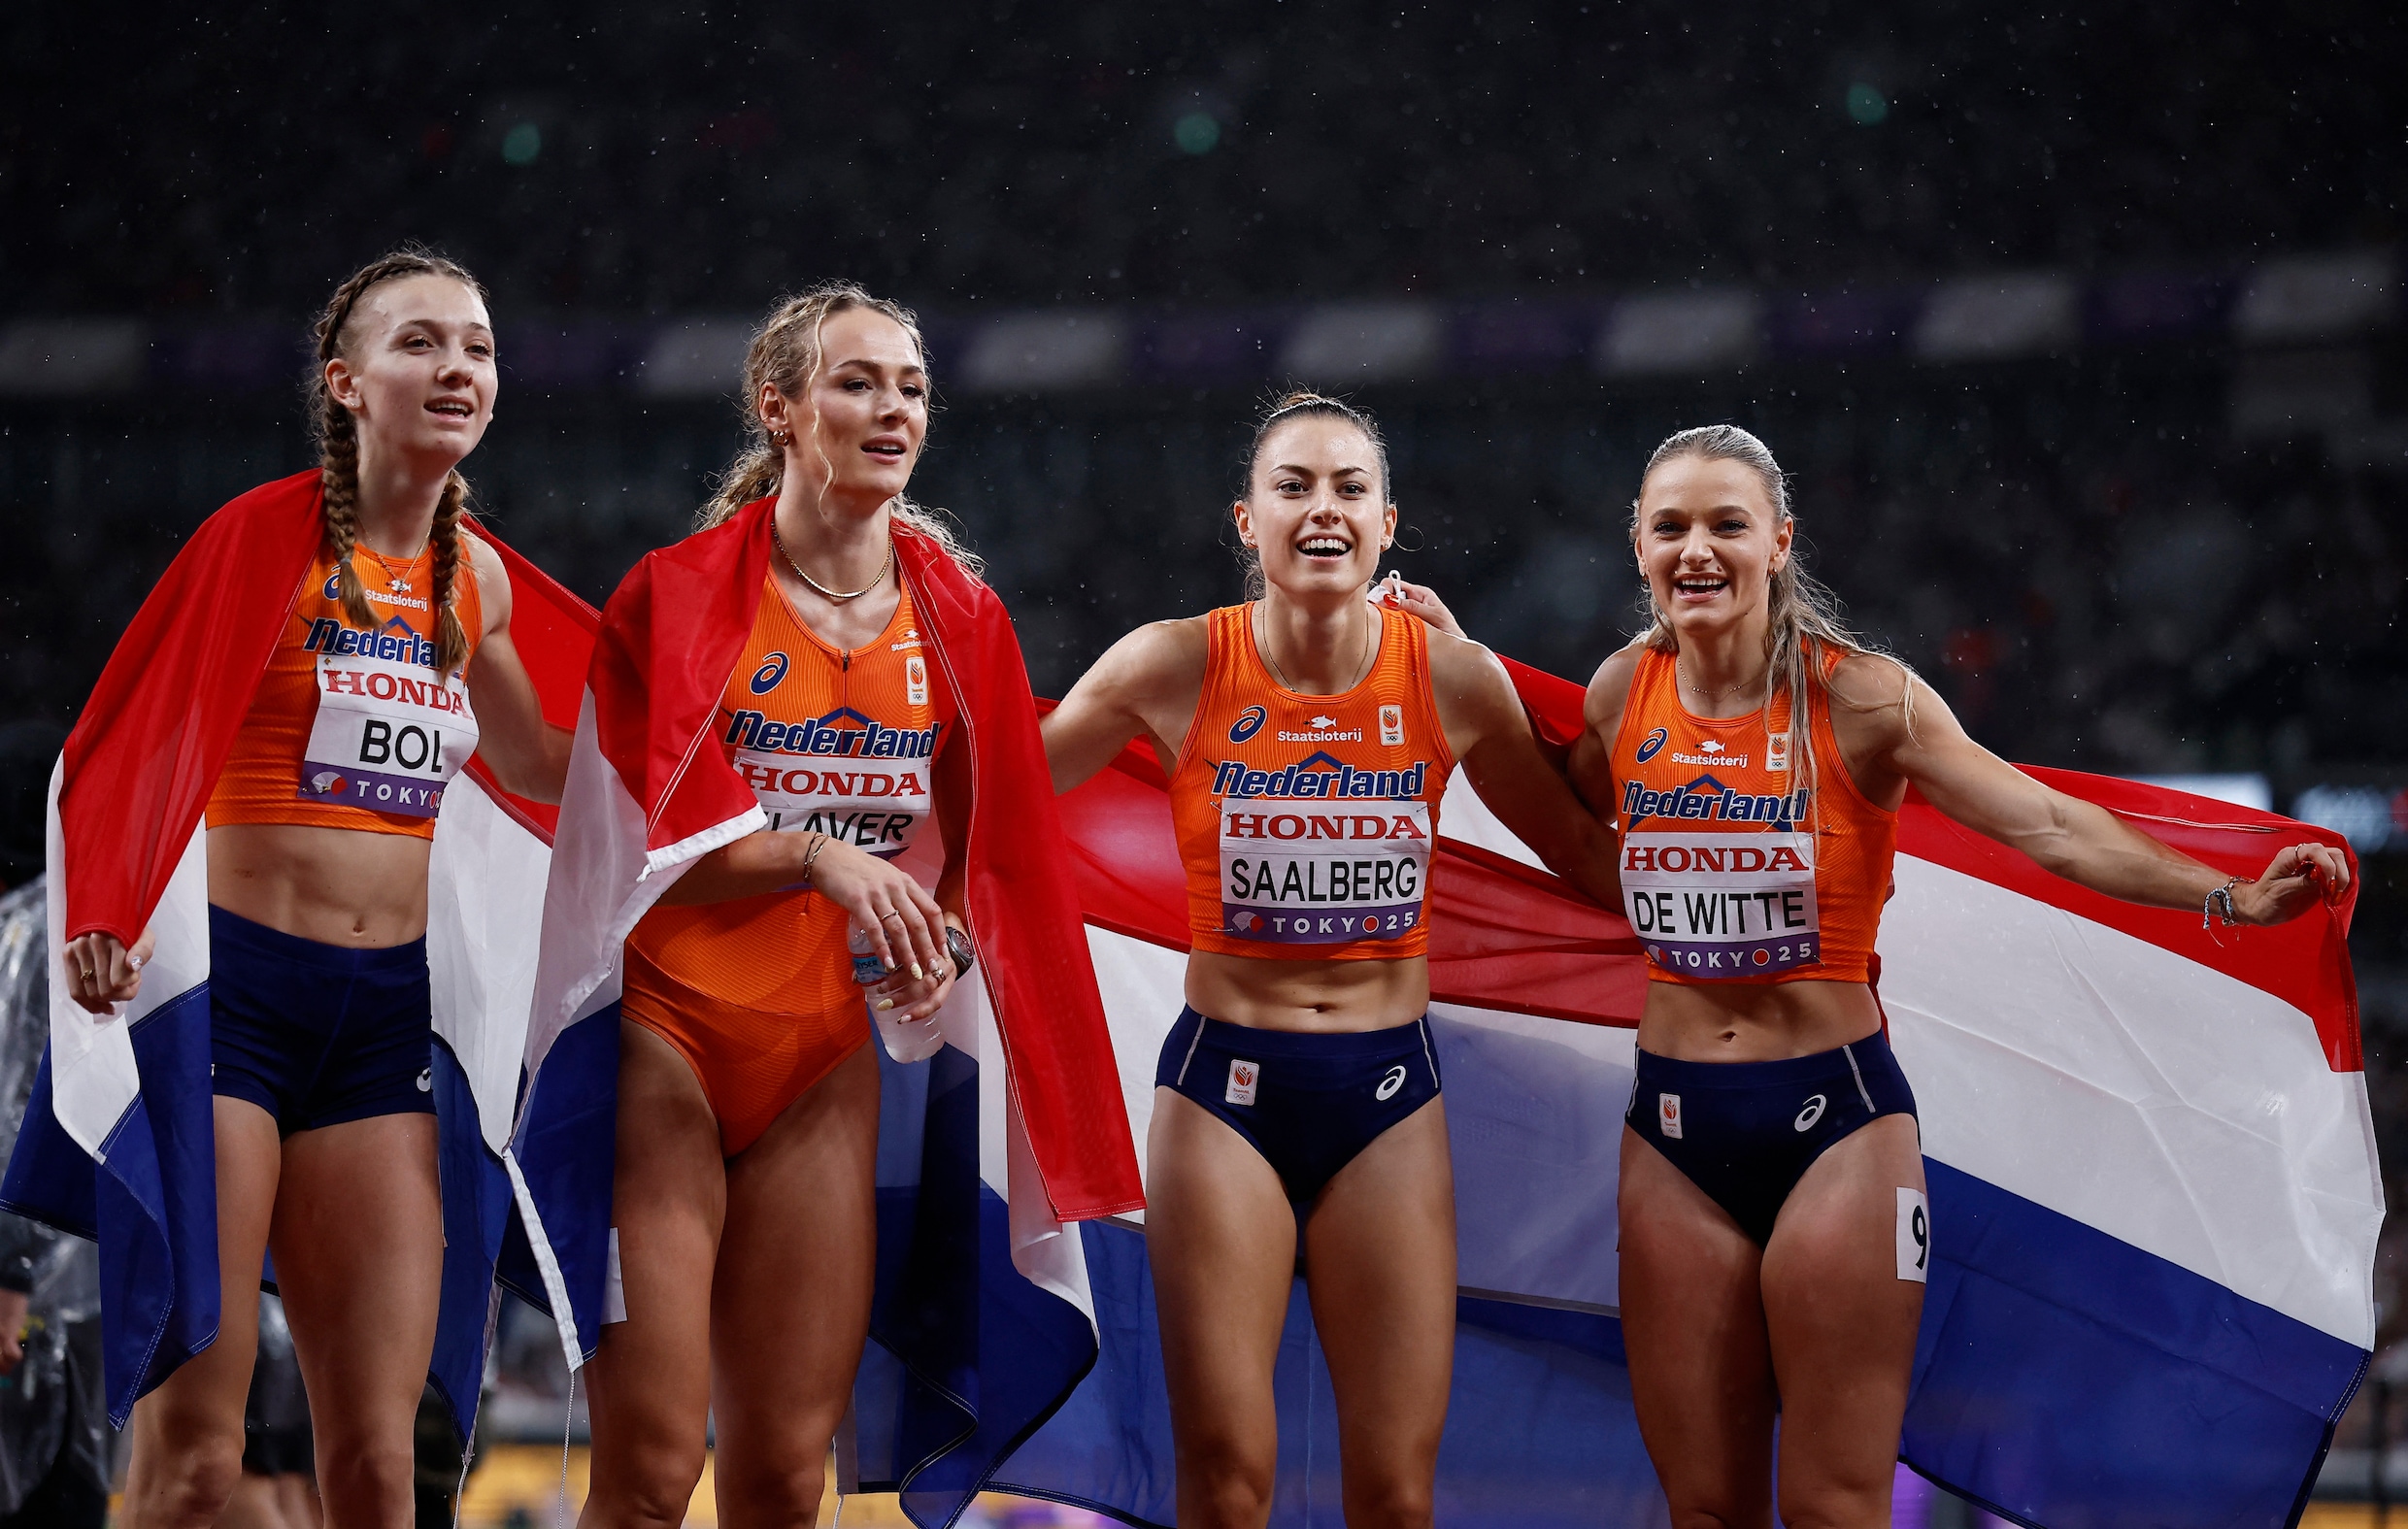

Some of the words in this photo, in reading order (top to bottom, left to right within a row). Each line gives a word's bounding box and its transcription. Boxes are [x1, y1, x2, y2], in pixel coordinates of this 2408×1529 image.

[365, 589, 428, 613] Staatsloterij
[302, 616, 465, 676] Nederla
[323, 668, 474, 720] HONDA
[358, 718, 443, 774] BOL
[1277, 728, 1362, 742] Staatsloterij
[1671, 752, 1748, 768] Staatsloterij
[739, 762, 926, 798] HONDA
[763, 812, 914, 847] AVER
[1225, 814, 1427, 841] HONDA
[1623, 847, 1810, 873] HONDA
[1230, 857, 1418, 902] SAALBERG
[1632, 891, 1676, 934] DE
[1684, 890, 1806, 935] WITTE
[1911, 1205, 1927, 1271] 9
